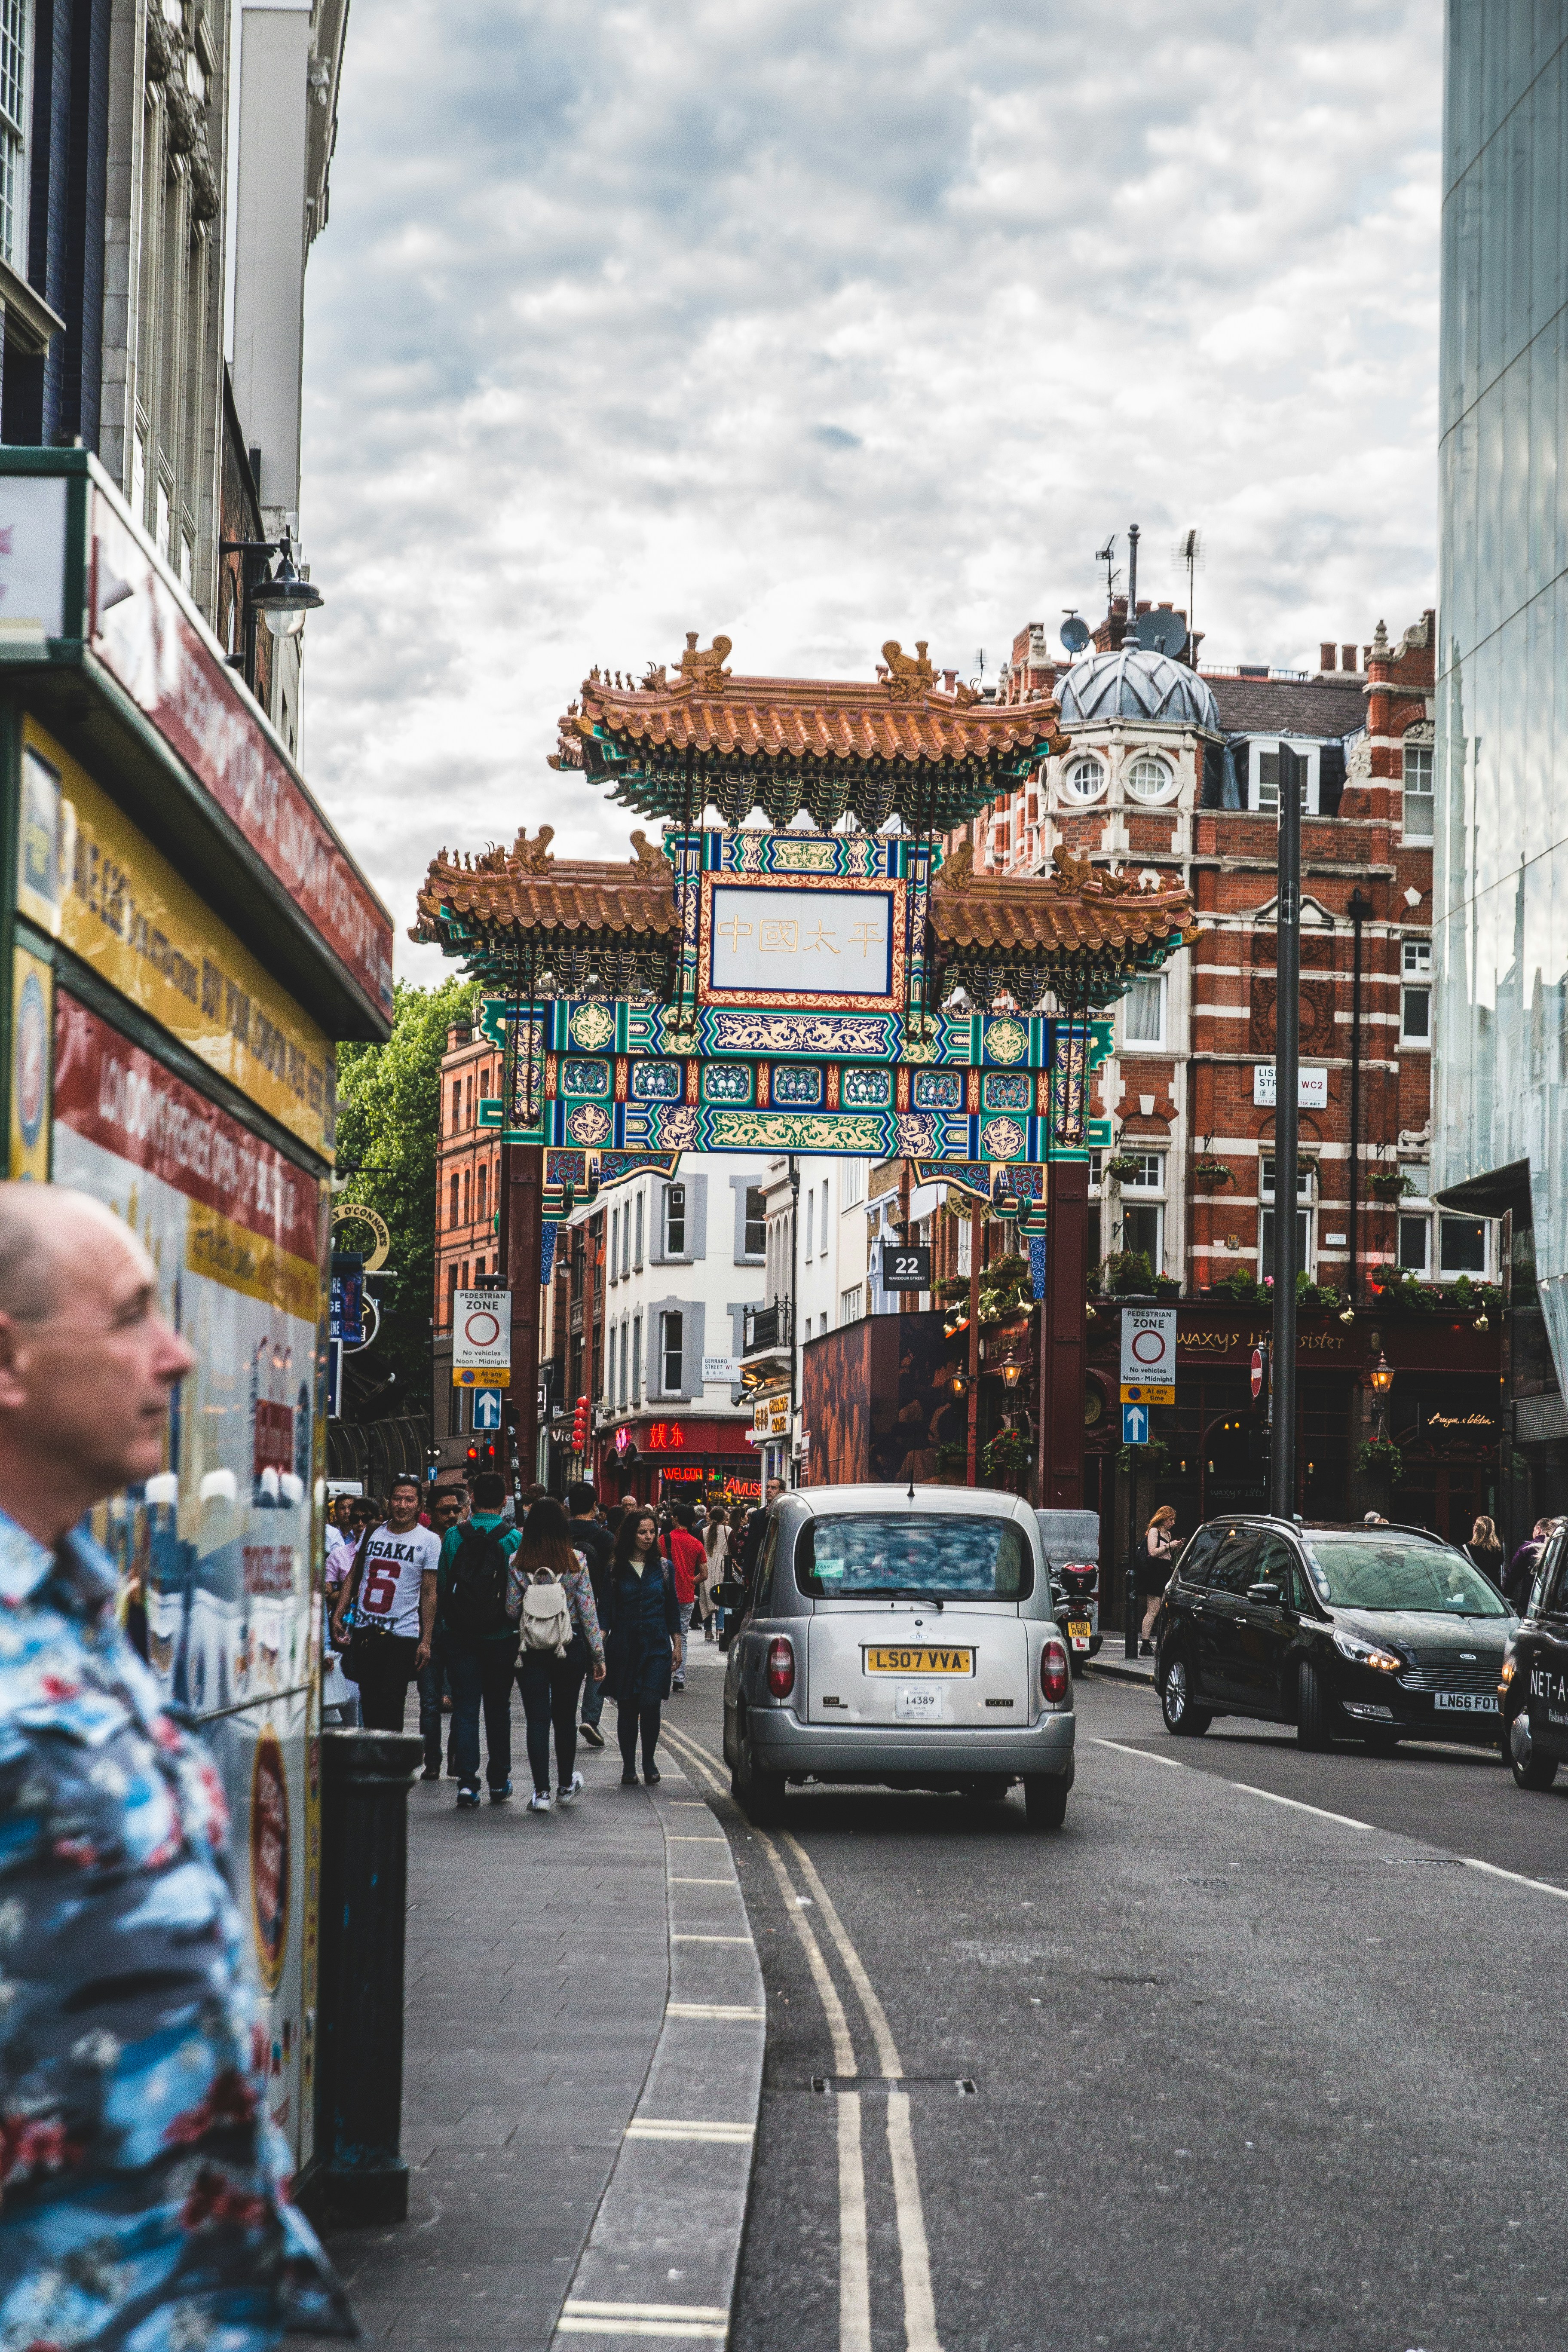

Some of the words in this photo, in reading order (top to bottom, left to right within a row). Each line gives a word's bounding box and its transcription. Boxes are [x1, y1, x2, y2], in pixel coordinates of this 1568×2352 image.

[717, 914, 885, 957] 中國太平
[1259, 1069, 1276, 1077] LIS
[1259, 1079, 1276, 1087] STR
[1302, 1081, 1323, 1089] WC2
[895, 1257, 918, 1274] 22
[466, 1301, 499, 1310] ZONE
[1133, 1319, 1164, 1328] ZONE
[649, 1423, 684, 1448] 娱乐
[365, 1540, 416, 1563] OSAKA
[362, 1558, 401, 1615] 6
[1076, 1638, 1085, 1648] L
[876, 1651, 922, 1668] LS07
[928, 1652, 962, 1669] VVA
[906, 1696, 934, 1704] 14389
[1440, 1694, 1472, 1708] LN66
